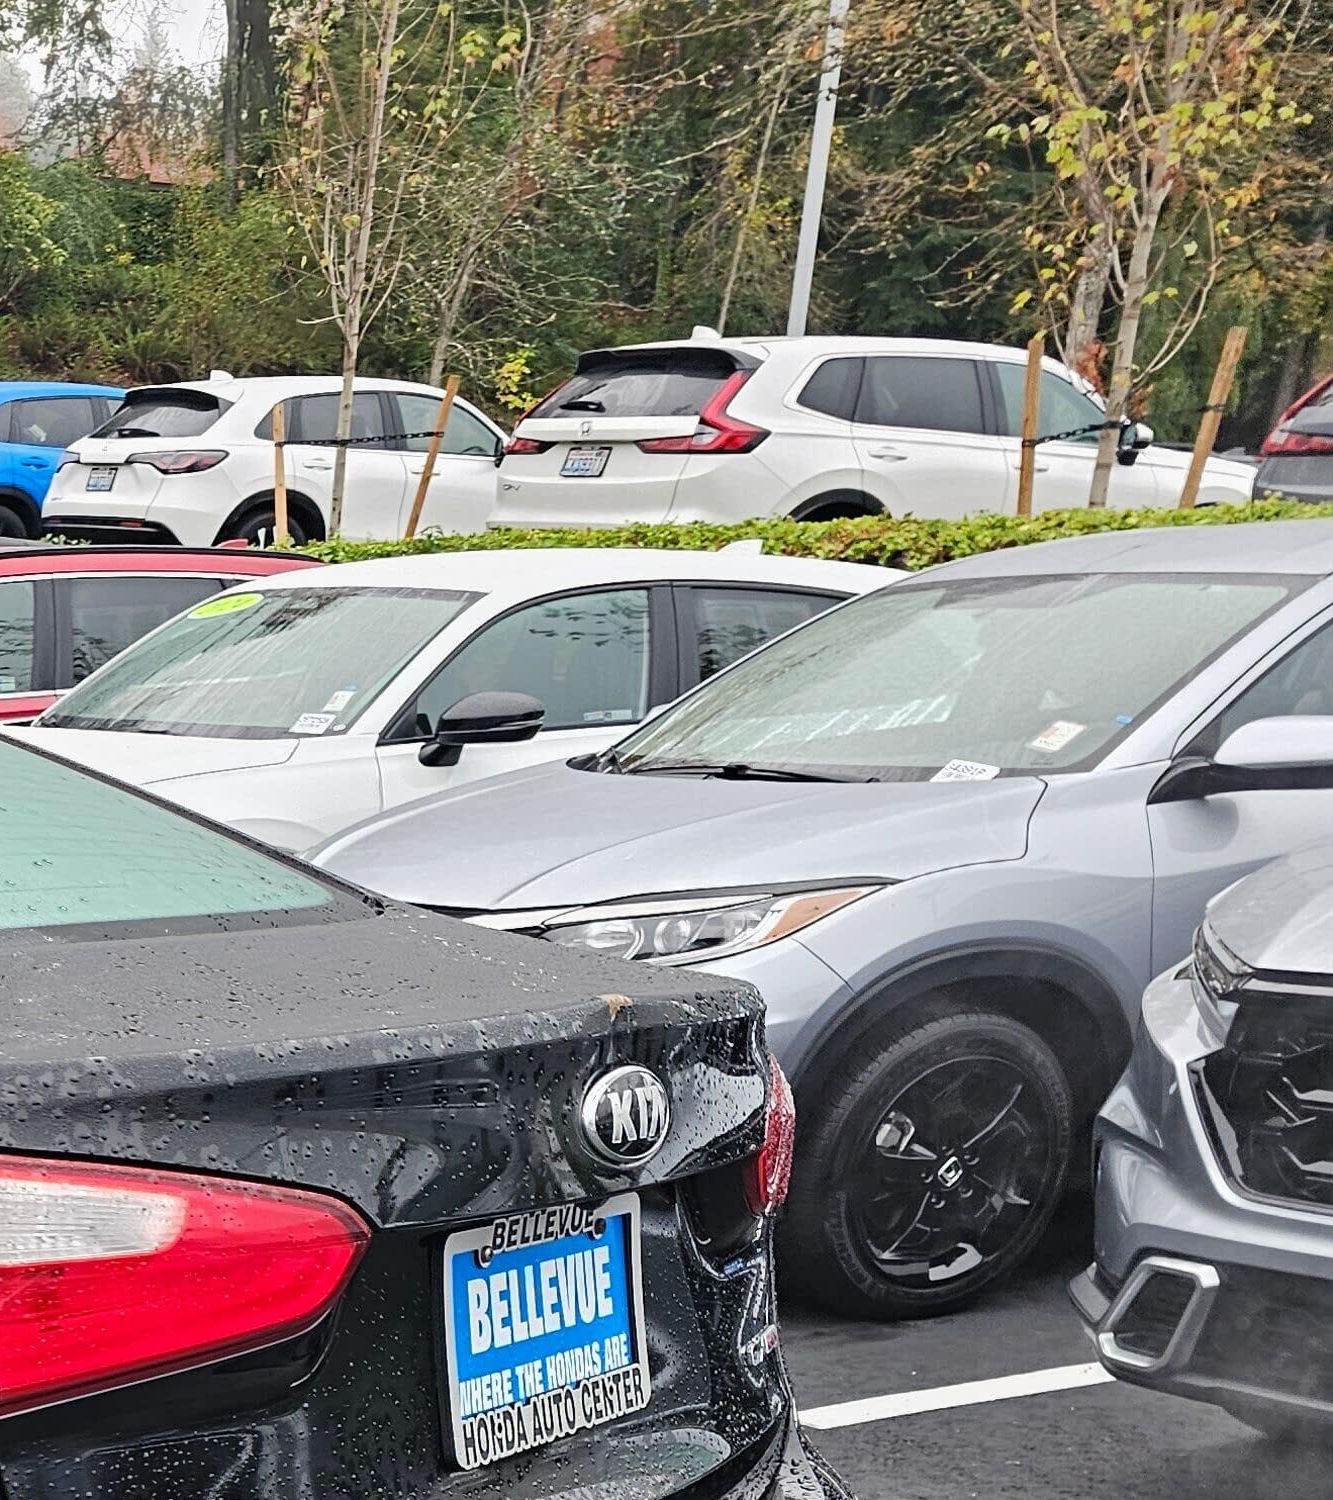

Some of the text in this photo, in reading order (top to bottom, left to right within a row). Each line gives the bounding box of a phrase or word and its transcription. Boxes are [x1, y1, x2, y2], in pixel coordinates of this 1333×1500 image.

[607, 1085, 666, 1144] KIA
[491, 1205, 594, 1251] BELLEVUE
[467, 1246, 613, 1354] BELLEVUE
[459, 1334, 629, 1417] WHERE THE HONDAS ARE
[462, 1367, 644, 1466] HONDA AUTO CENTER
